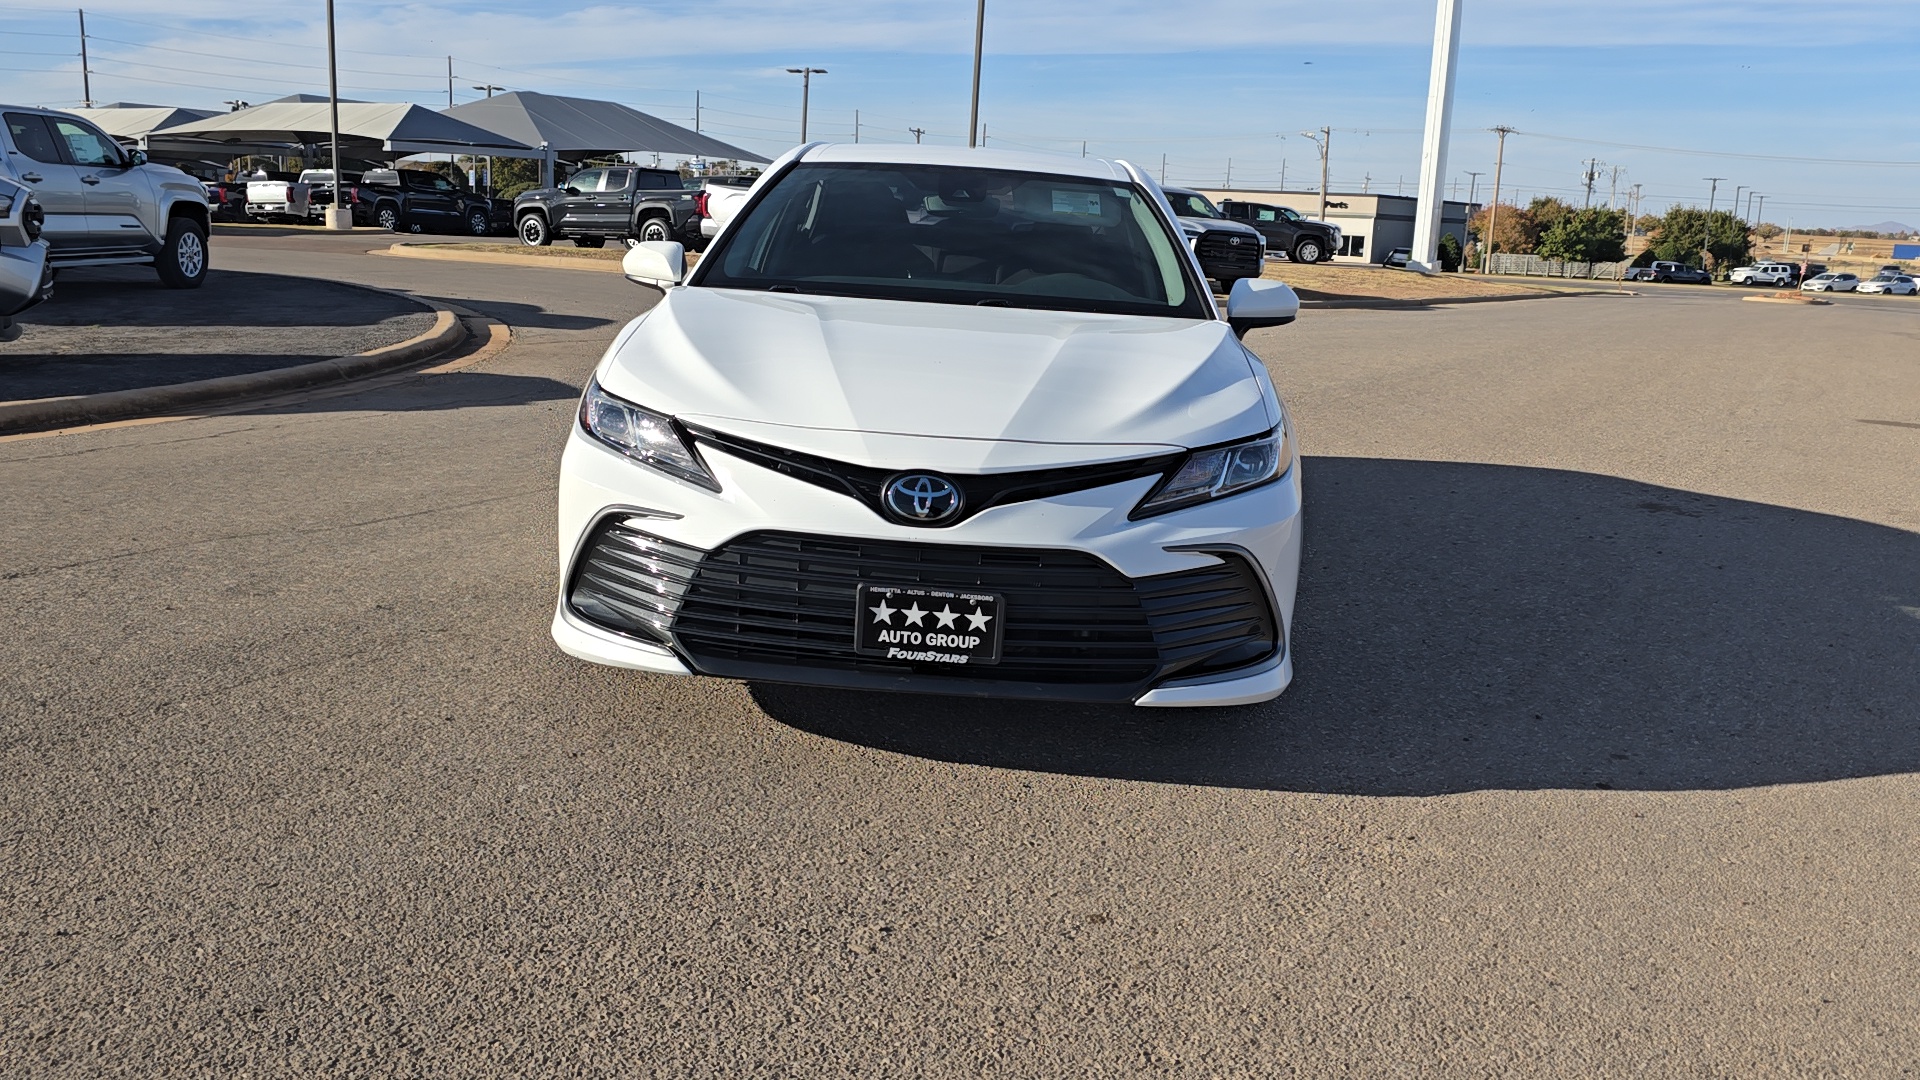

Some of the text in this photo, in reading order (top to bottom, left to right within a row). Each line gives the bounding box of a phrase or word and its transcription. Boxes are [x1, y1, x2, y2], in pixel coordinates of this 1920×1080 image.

[870, 586, 901, 594] HENRIETTA
[960, 593, 993, 601] JACKSBORO
[878, 629, 980, 649] AUTO GROUP
